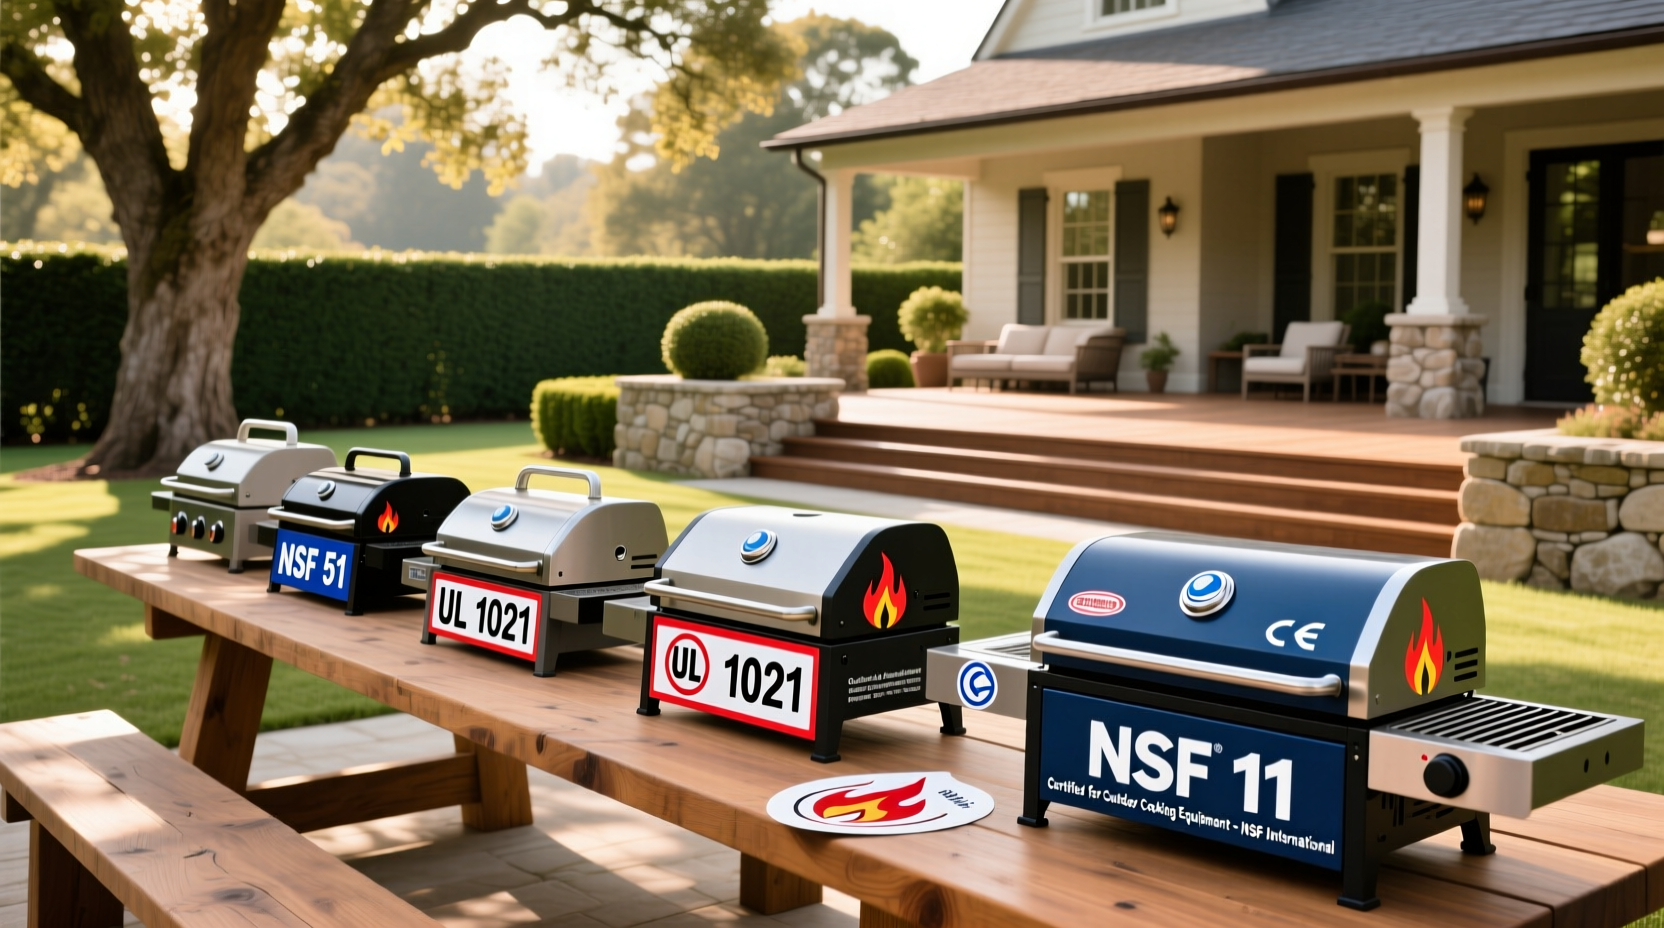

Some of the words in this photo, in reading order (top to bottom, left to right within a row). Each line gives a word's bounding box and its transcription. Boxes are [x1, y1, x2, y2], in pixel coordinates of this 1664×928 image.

[278, 542, 319, 581] NSF
[322, 551, 347, 589] 51
[439, 587, 467, 629] UL
[476, 596, 530, 645] 1021
[1265, 619, 1326, 652] CE
[672, 645, 702, 683] UL
[724, 654, 802, 713] 1021
[1233, 752, 1293, 821] 11
